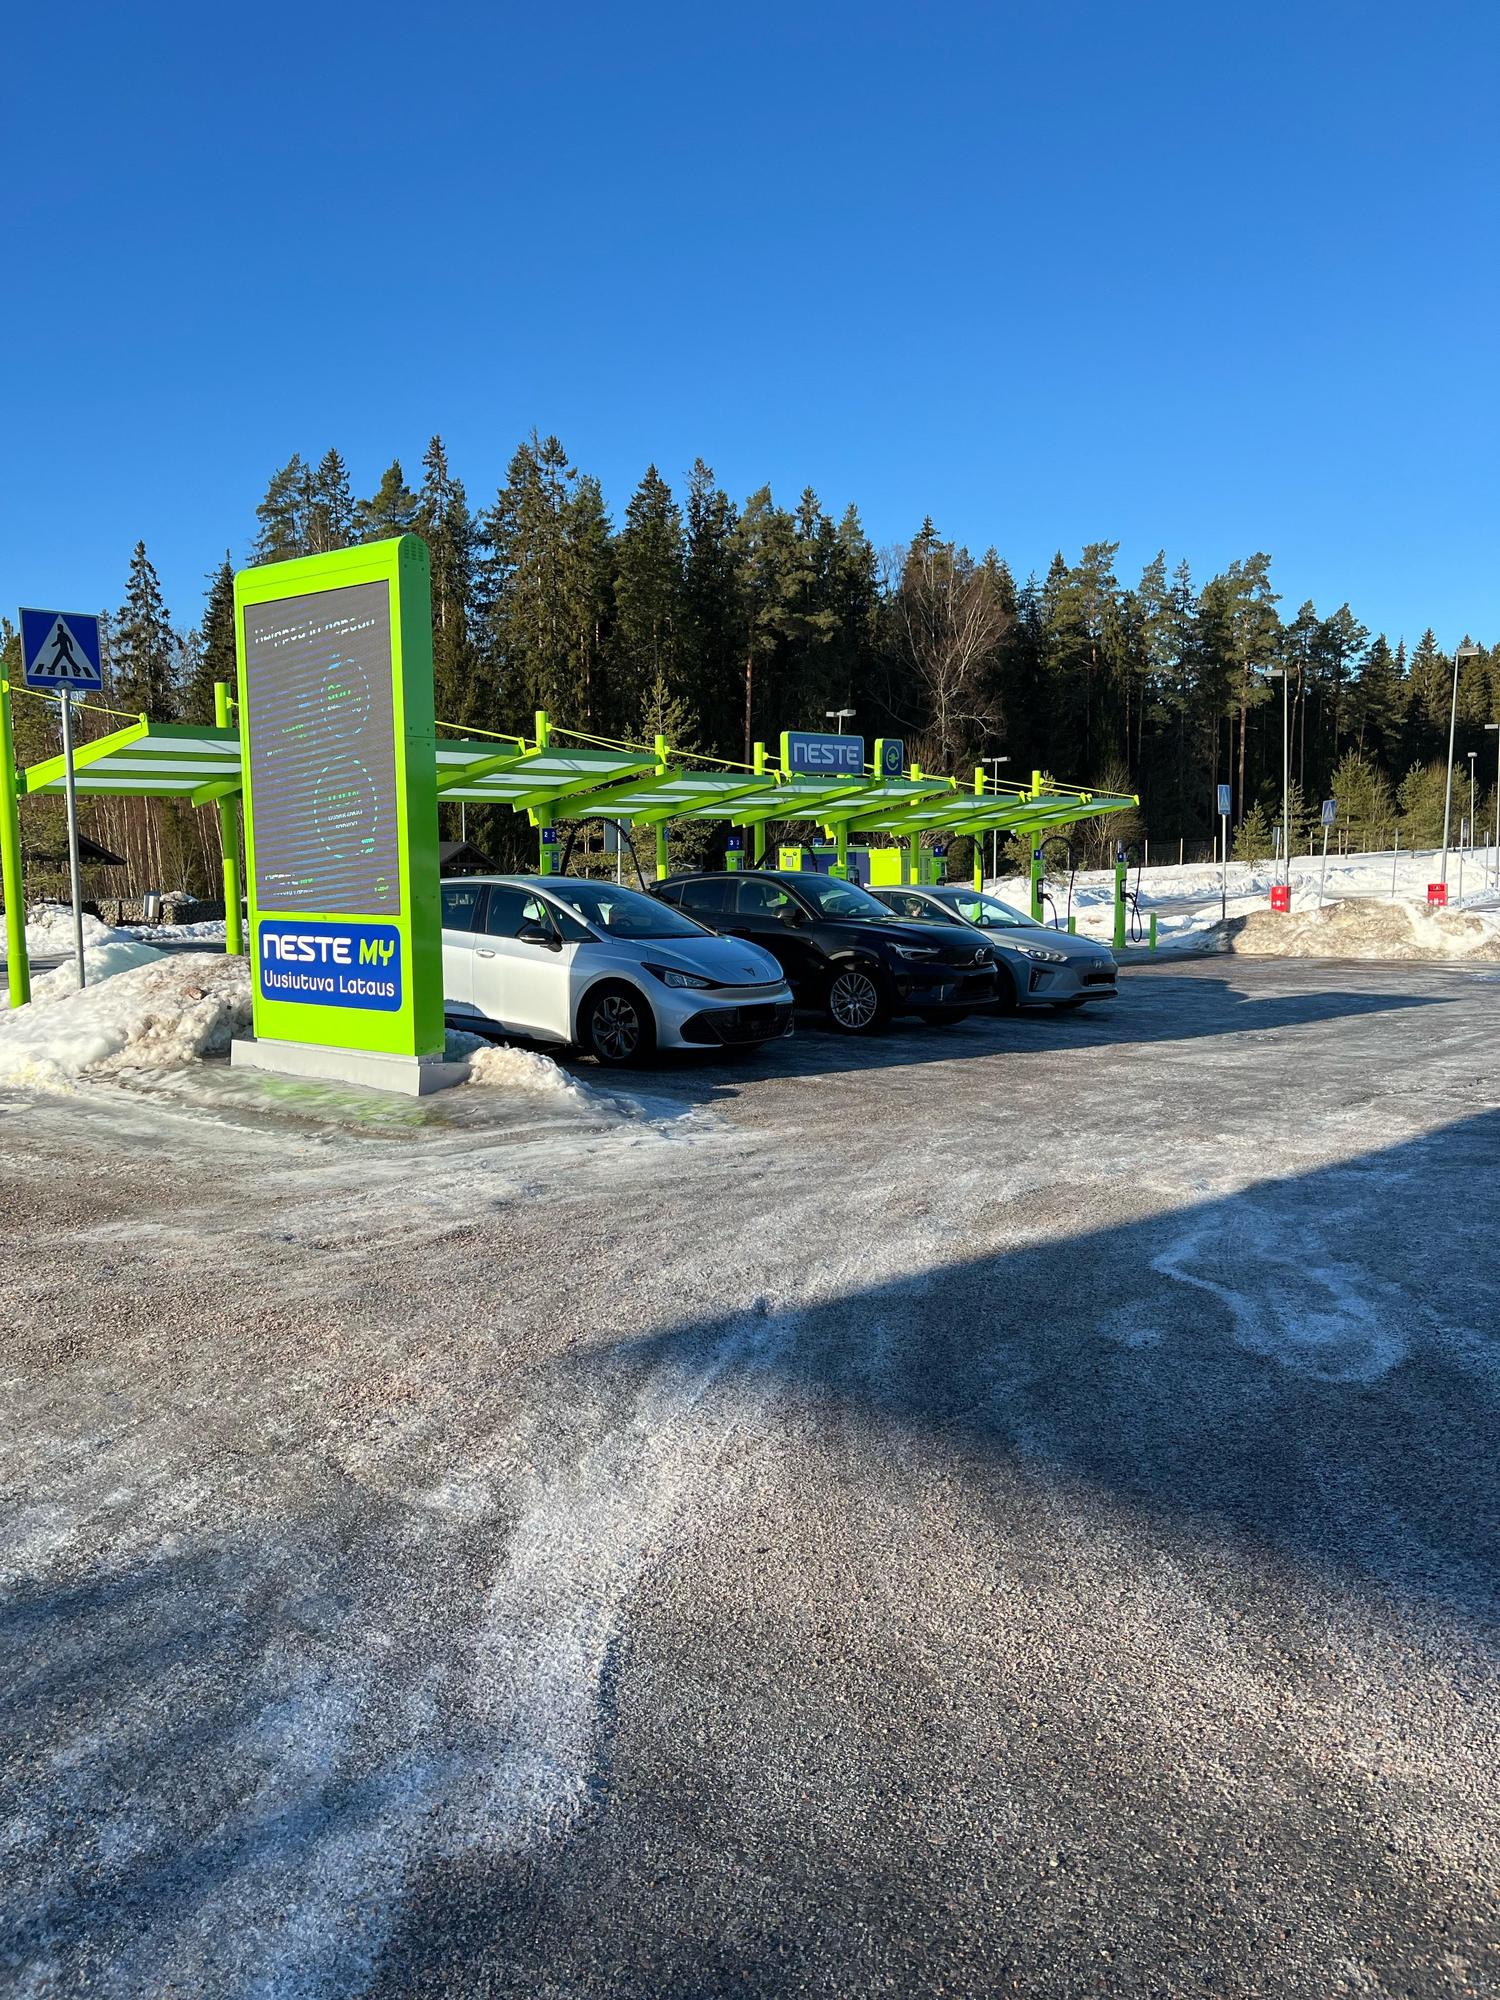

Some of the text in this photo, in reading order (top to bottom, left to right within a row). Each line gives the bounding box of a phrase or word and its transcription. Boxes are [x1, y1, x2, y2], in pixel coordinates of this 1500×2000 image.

[793, 742, 859, 766] NESTE
[262, 933, 395, 966] NESTE MY
[264, 969, 395, 997] Uusiutuva Lataus
